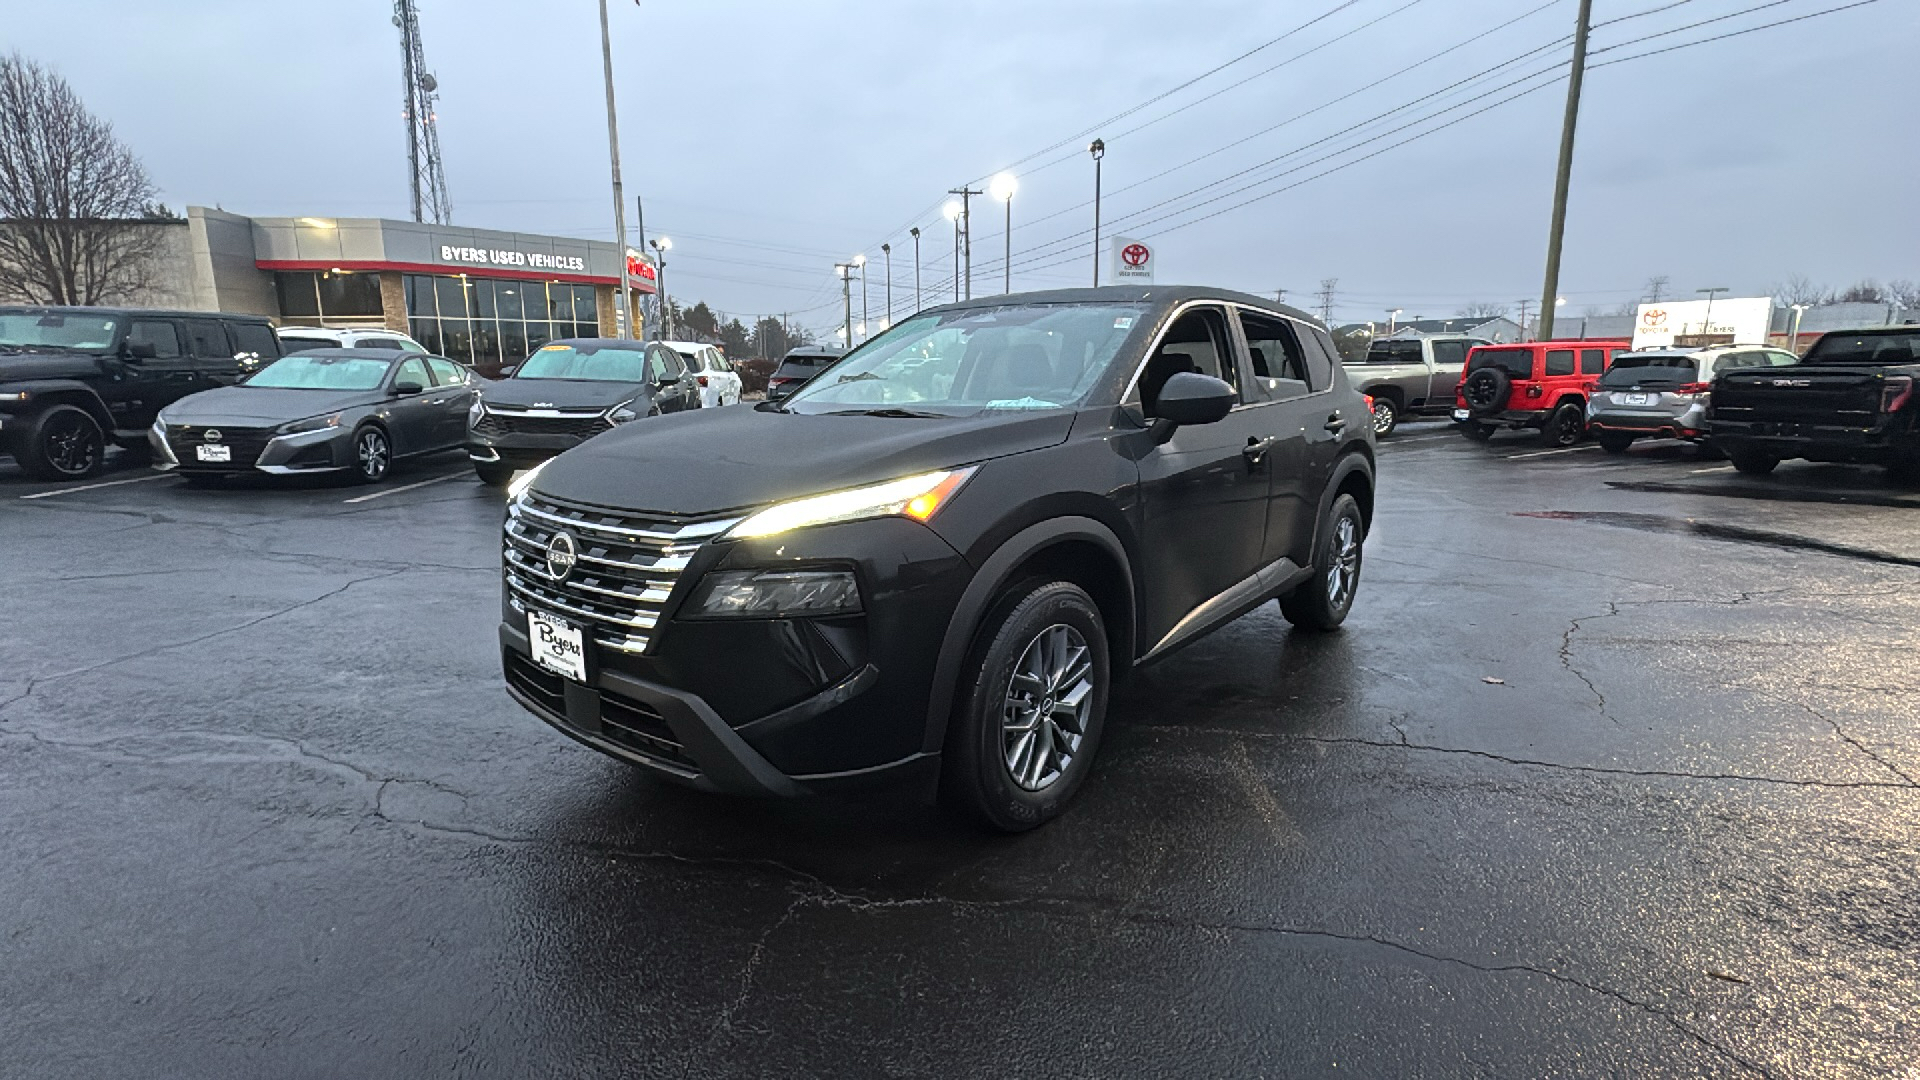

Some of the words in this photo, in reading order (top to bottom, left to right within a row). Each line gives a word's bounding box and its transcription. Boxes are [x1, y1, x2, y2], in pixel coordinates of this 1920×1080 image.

[441, 245, 488, 263] BYERS
[489, 249, 525, 266] USED
[527, 253, 585, 271] VEHICLES
[533, 621, 580, 657] Byers
